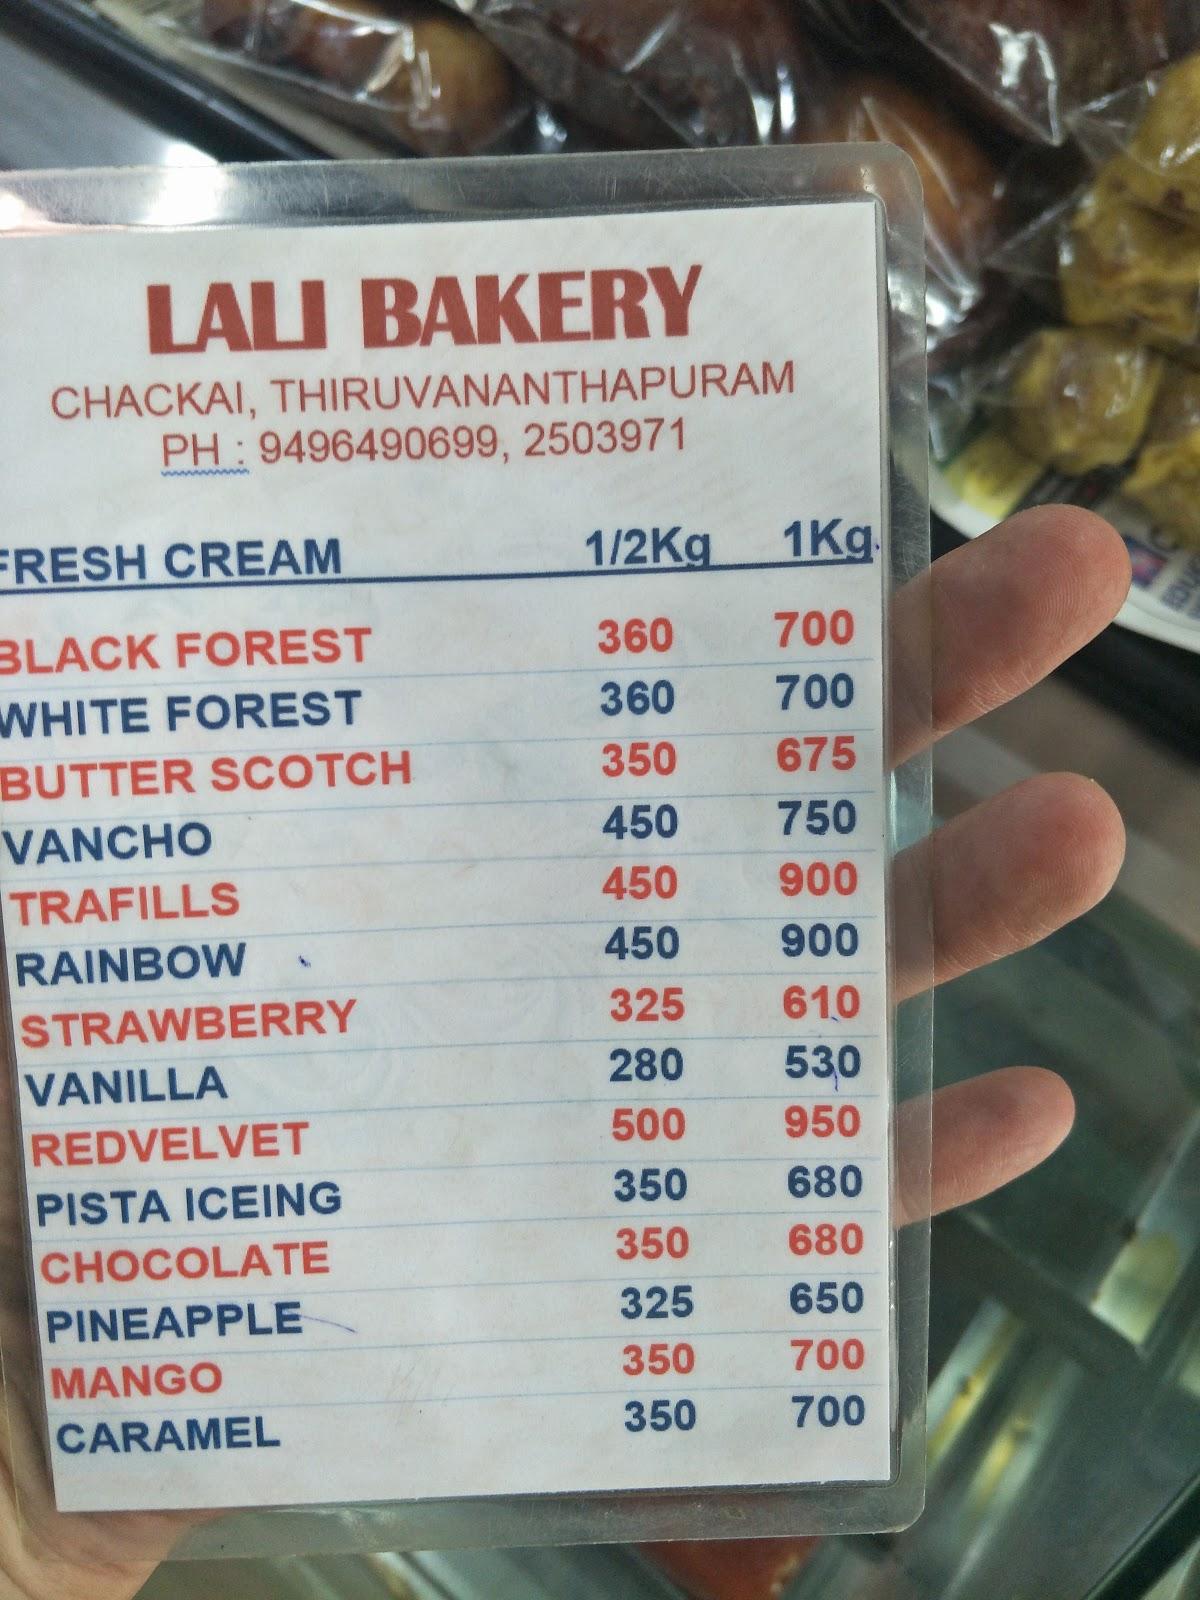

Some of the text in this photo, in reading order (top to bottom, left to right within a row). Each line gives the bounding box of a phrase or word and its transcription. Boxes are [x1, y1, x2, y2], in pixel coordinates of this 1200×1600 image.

[147, 264, 703, 355] LALI BAKERY
[51, 360, 794, 420] CHACKAI, THIRUVANANTHAPURAM
[259, 424, 509, 464] 9496490699,
[524, 416, 684, 457] 2503971
[164, 537, 343, 579] CREAM
[585, 526, 711, 569] 1/2Kg
[0, 609, 854, 676] BLACK FOREST 360 700
[0, 672, 855, 739] WHITE FOREST 360 700
[0, 735, 857, 802] BUTTER SCOTCH 350 675
[2, 799, 857, 866] VANCHO 450 750
[8, 861, 858, 927] TRAFILLS 450 900
[15, 922, 859, 987] RAINBOW 450 900
[20, 984, 861, 1049] STRAWBERRY 325 610
[24, 1044, 862, 1107] VANILLA 280 530
[31, 1104, 861, 1168] REDVELVET 500 950
[36, 1164, 863, 1227] PISTA ICEING 350 680
[40, 1222, 864, 1285] CHOCOLATE 350 680
[46, 1281, 864, 1344] PINEAPPLE 325 650
[50, 1338, 865, 1400] MANGO 350 700
[56, 1394, 866, 1455] CARAMEL 350 700
